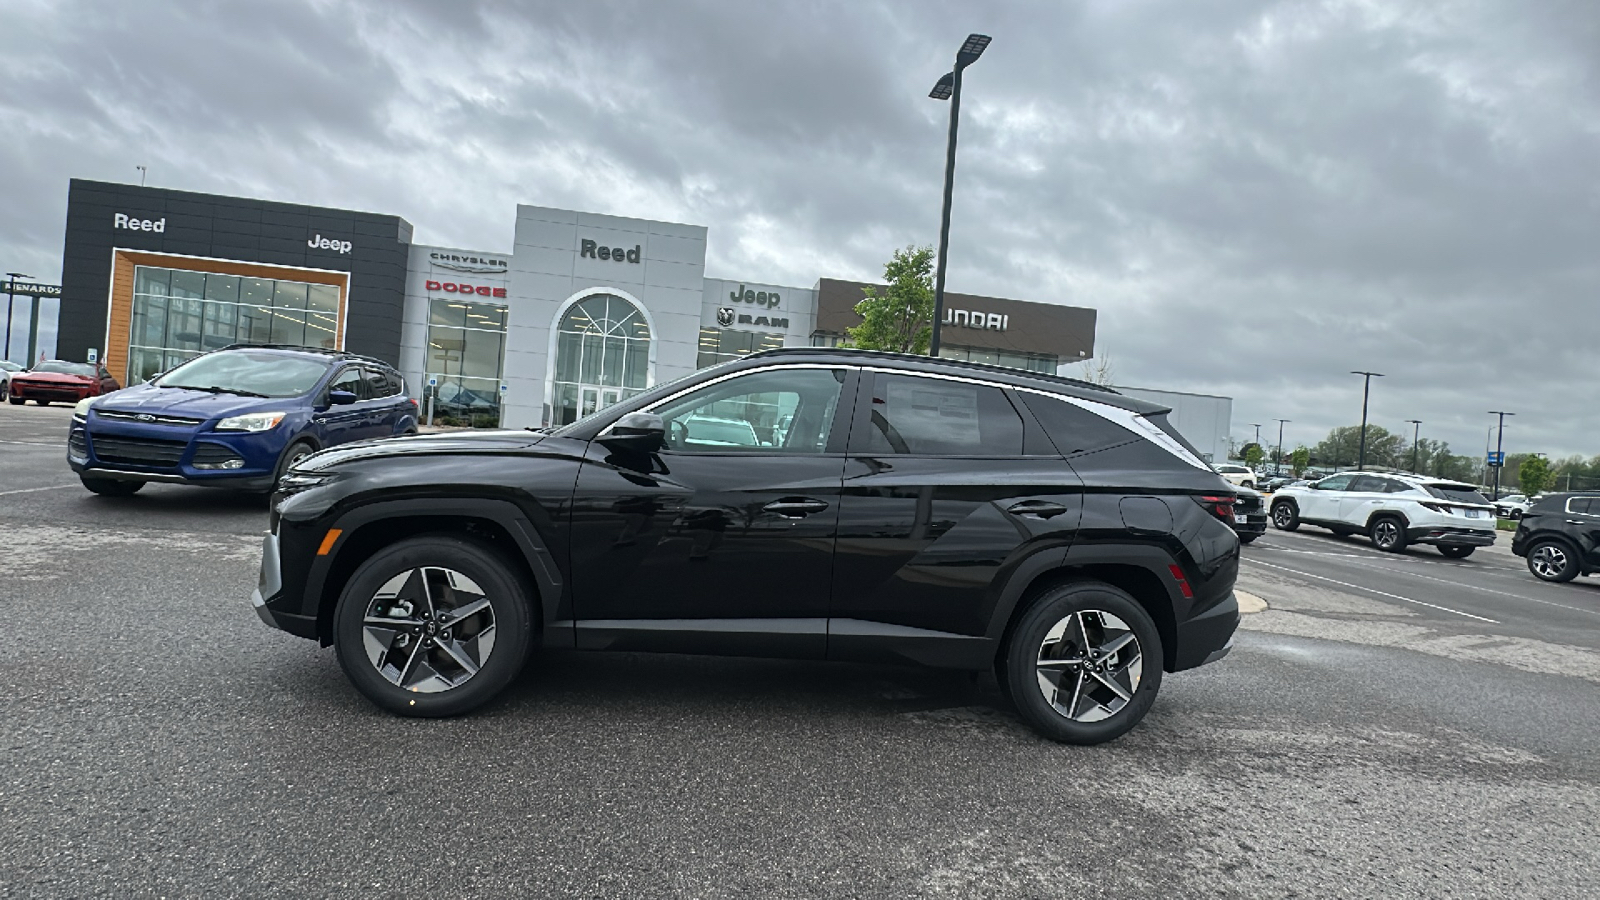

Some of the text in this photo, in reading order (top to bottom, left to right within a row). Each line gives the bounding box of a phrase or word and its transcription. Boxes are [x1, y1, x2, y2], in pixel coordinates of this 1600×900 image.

[114, 212, 166, 233] Reed
[307, 233, 352, 254] Jeep
[580, 238, 641, 264] Reed
[430, 252, 507, 268] CHRYSLER
[425, 279, 508, 299] DODGE
[730, 284, 781, 309] Jeep
[738, 313, 789, 329] RAM
[907, 305, 1009, 332] UNDAI
